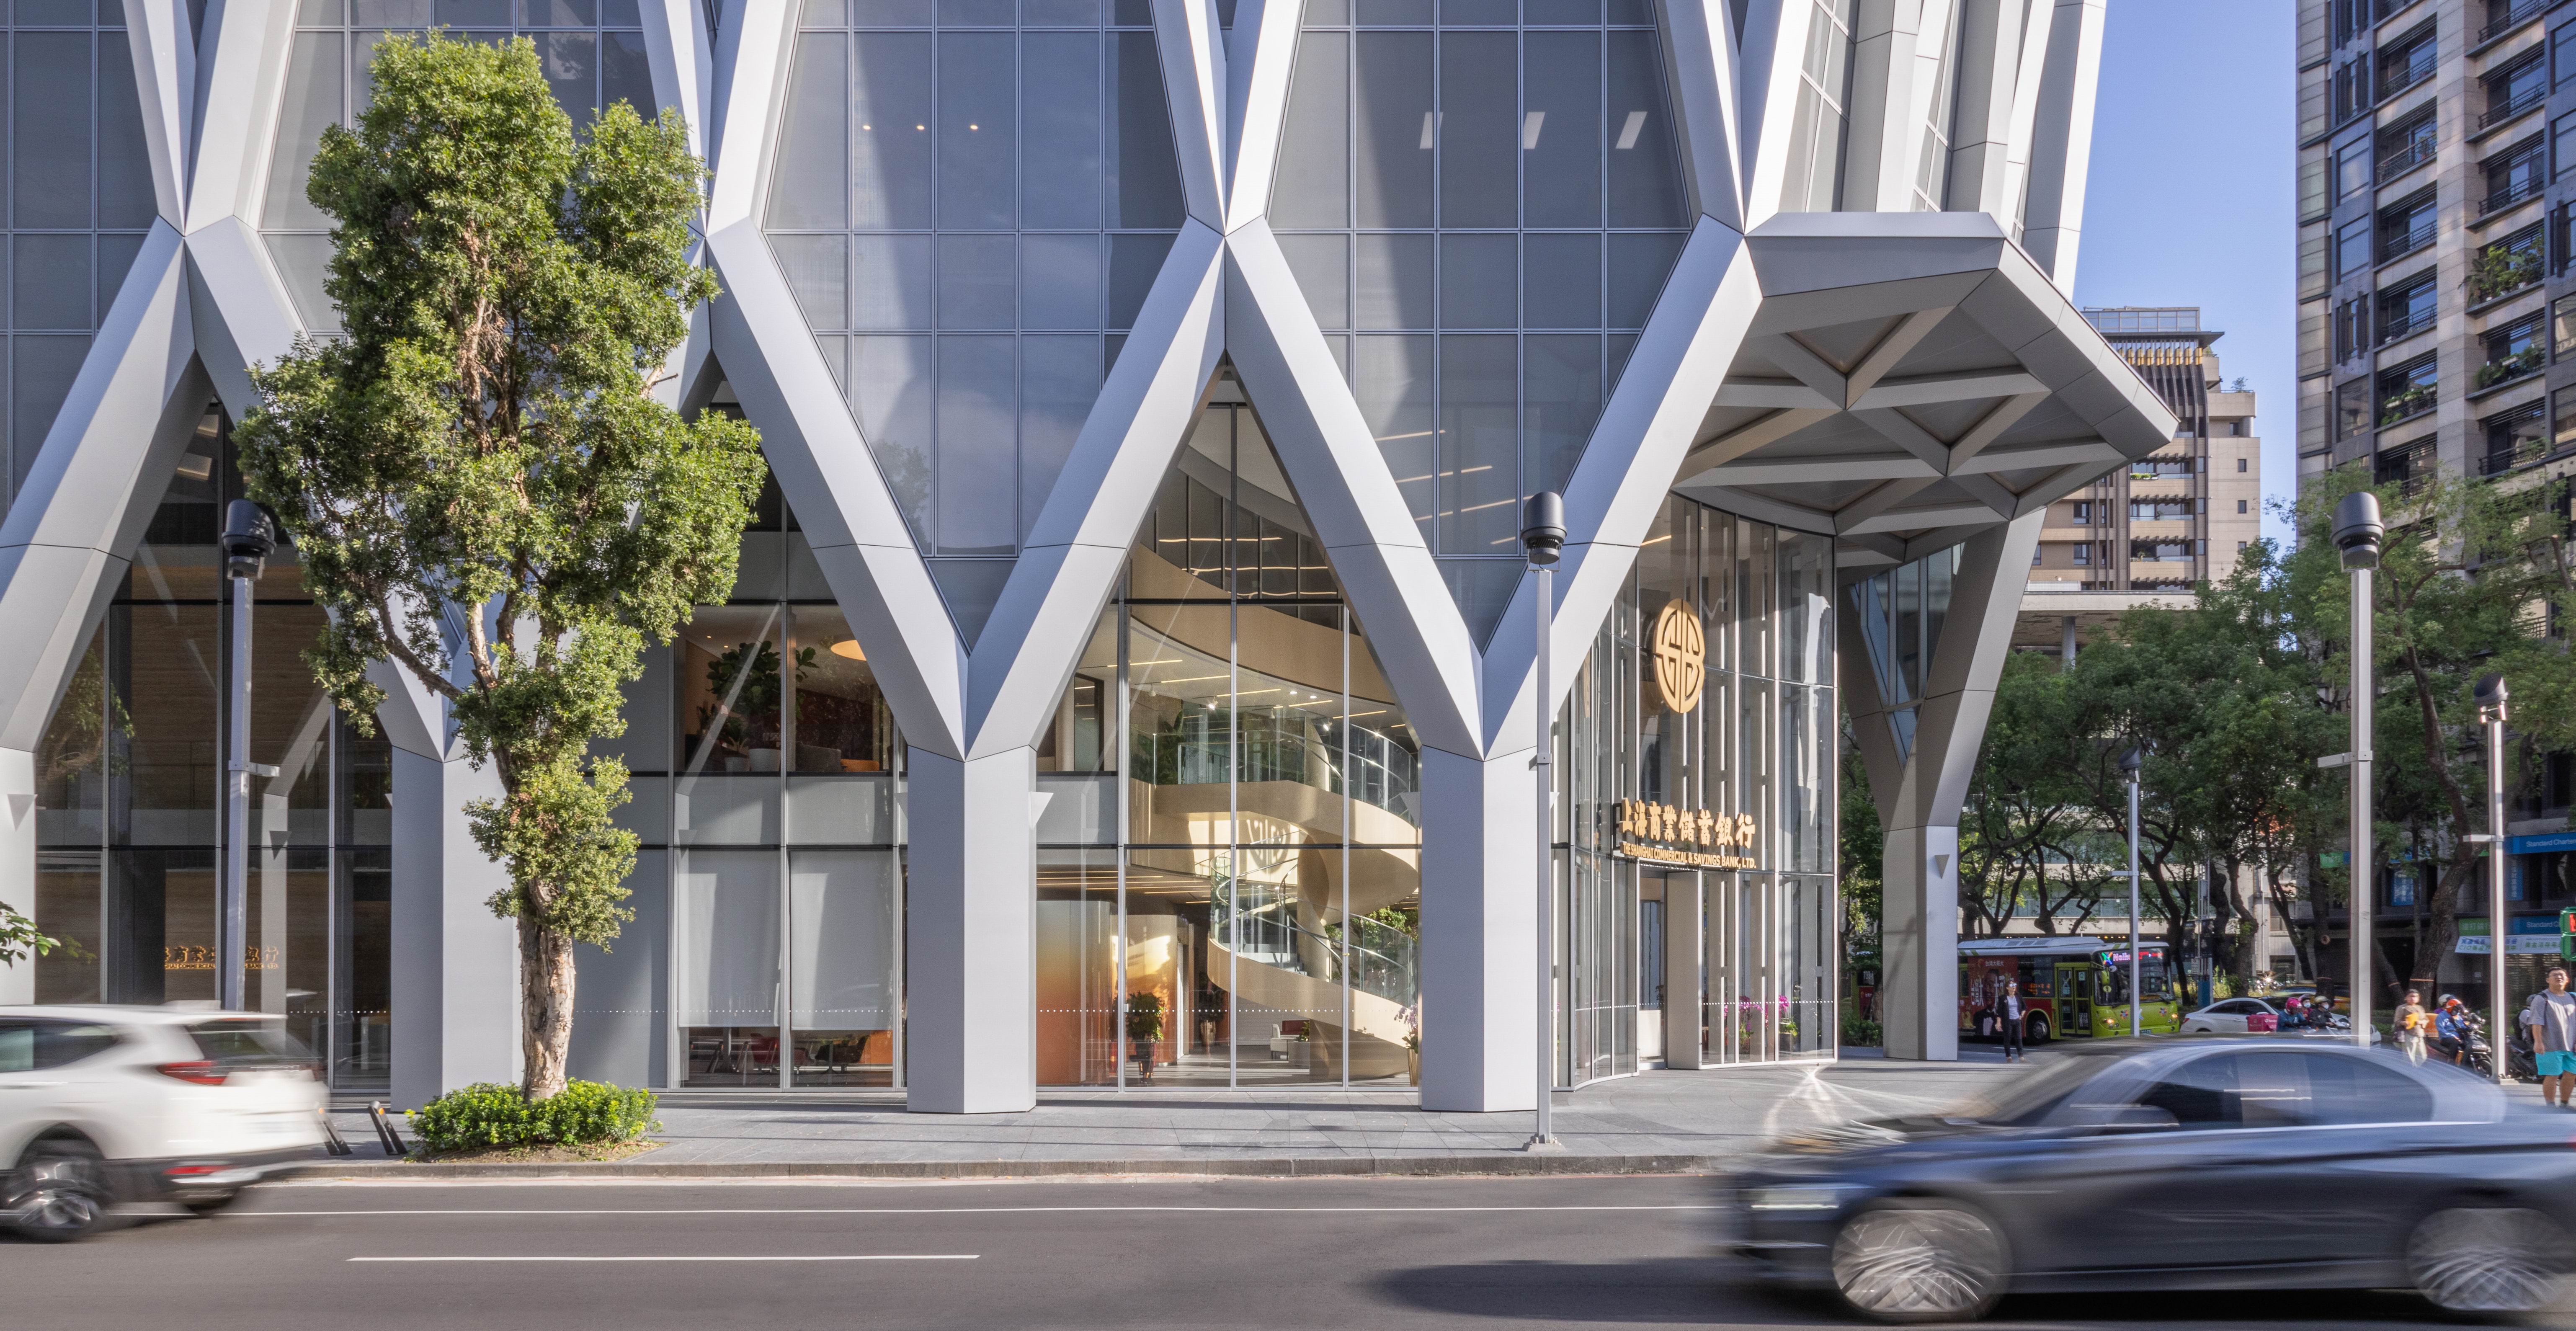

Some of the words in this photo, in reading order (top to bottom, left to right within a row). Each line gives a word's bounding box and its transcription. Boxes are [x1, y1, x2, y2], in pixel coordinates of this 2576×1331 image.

[1620, 797, 1756, 849] 上海商業儲蓄銀行
[1631, 844, 1654, 859] SHANGHAI
[1654, 848, 1688, 863] COMMERCIAL
[1688, 852, 1693, 864] &
[1694, 853, 1721, 866] SAVINGS
[1721, 856, 1741, 869] BANK,
[1742, 857, 1756, 868] LTD.
